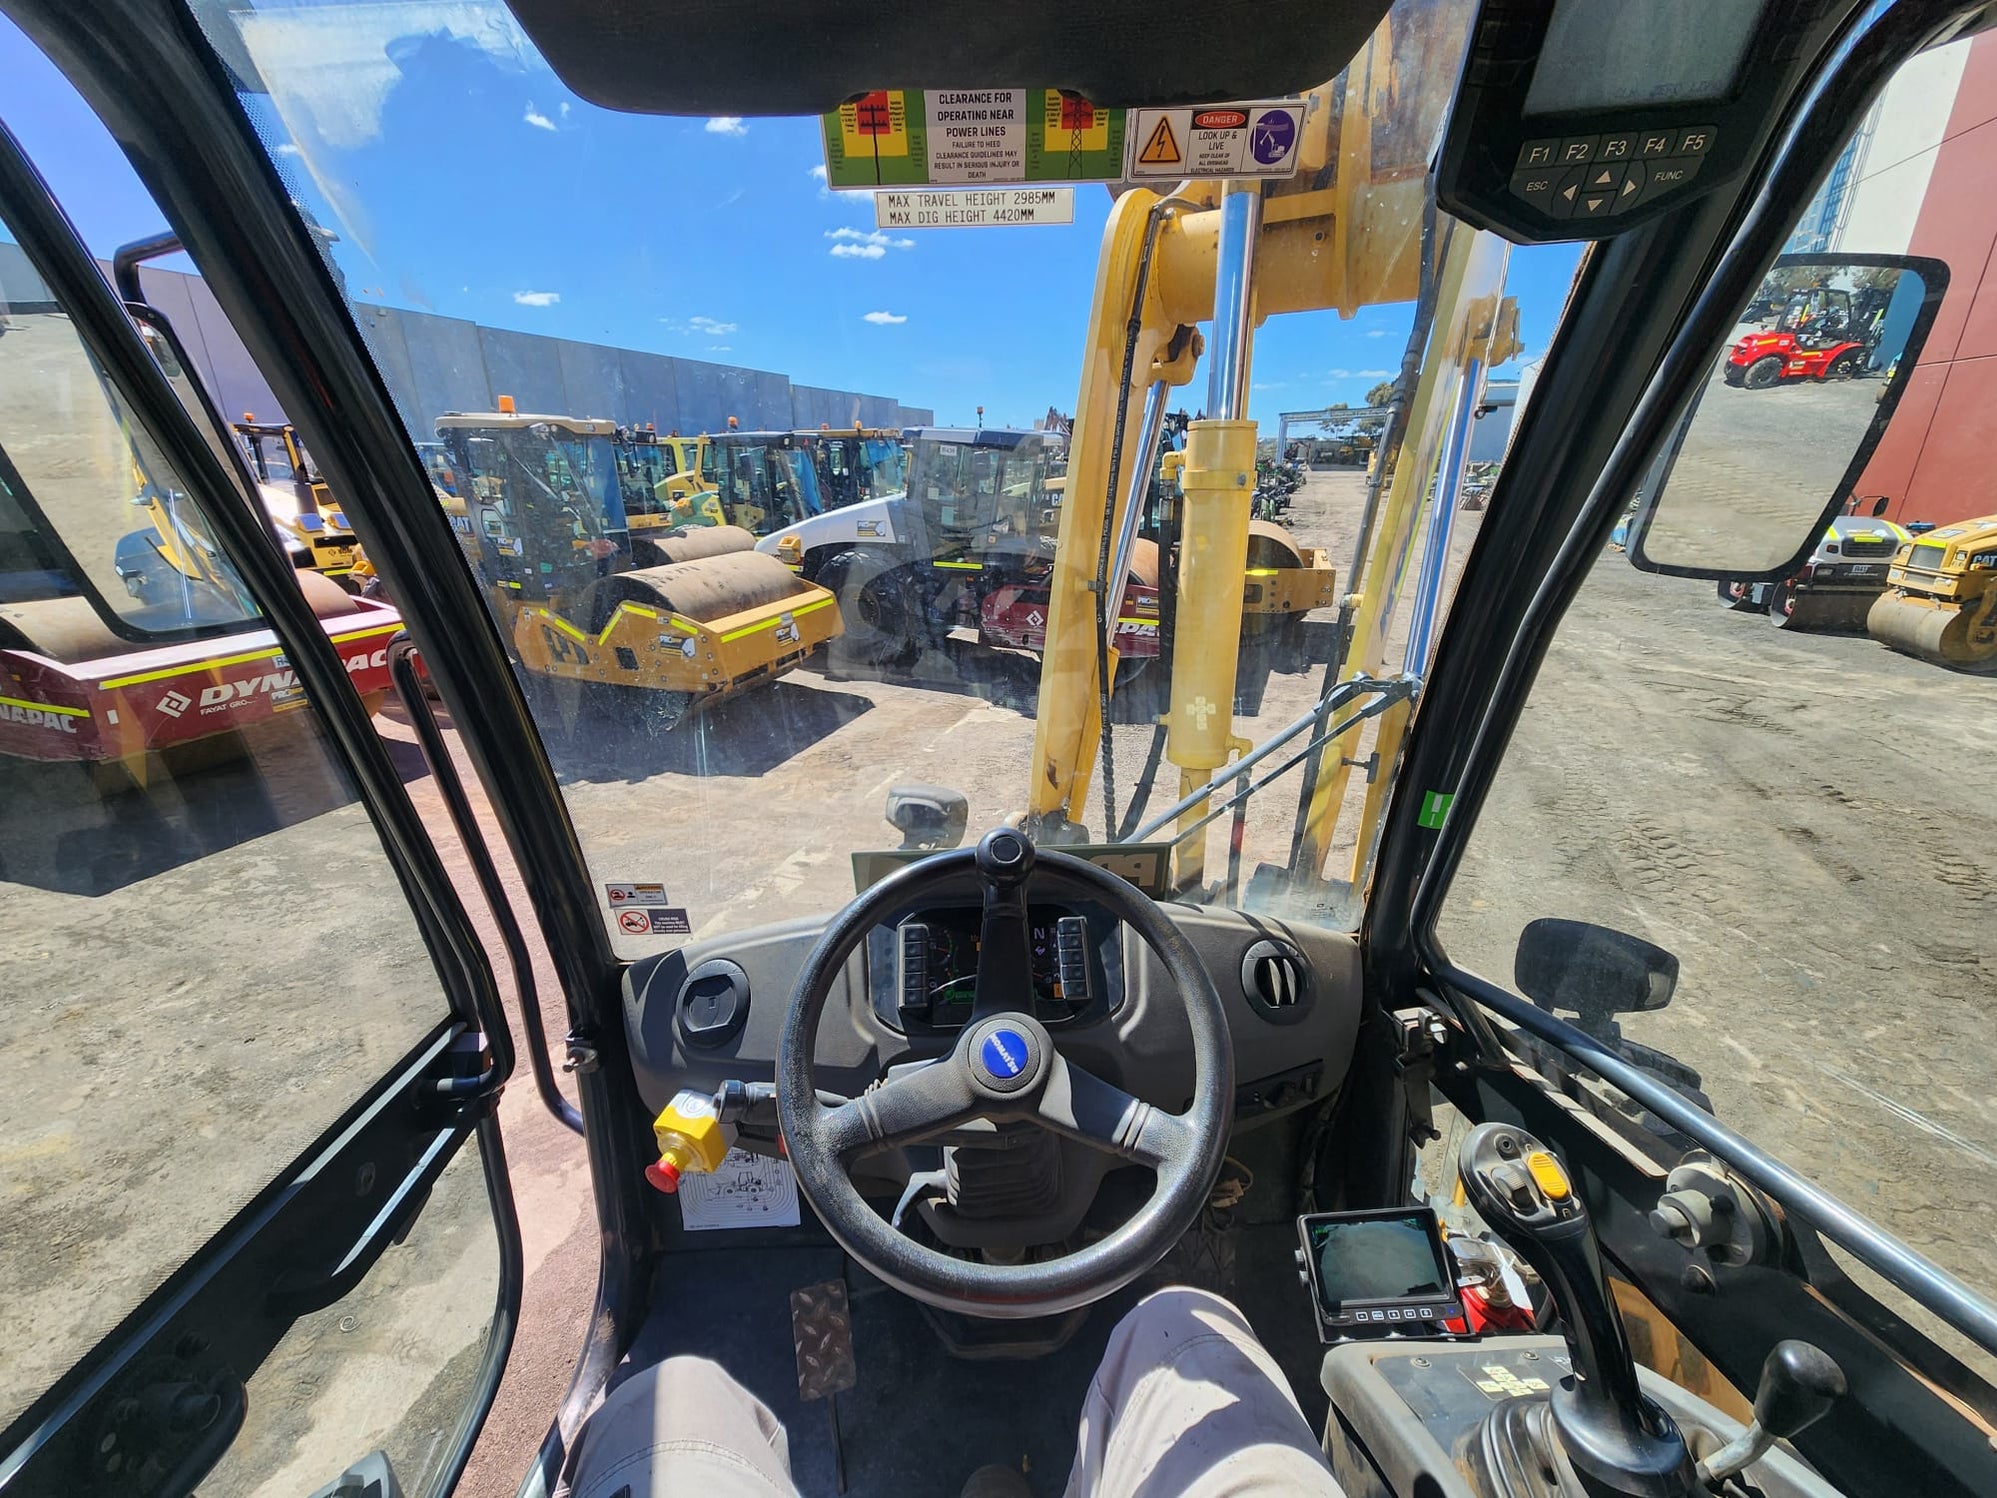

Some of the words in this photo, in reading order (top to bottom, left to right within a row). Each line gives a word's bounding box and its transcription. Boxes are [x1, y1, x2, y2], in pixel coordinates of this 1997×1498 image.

[939, 92, 992, 105] CLEARANCE
[994, 92, 1012, 103] FOR
[937, 110, 987, 121] OPERATING
[990, 109, 1014, 120] NEAR
[1202, 115, 1238, 124] DANGER
[946, 127, 978, 137] POWER
[980, 126, 1006, 136] LINES
[1198, 131, 1218, 140] LOOK
[1220, 131, 1230, 139] UP
[1231, 131, 1238, 139] &
[952, 141, 975, 149] FAILURE
[1208, 141, 1224, 150] LIVE
[1529, 147, 1550, 164] F1
[1565, 143, 1589, 160] F2
[1604, 140, 1626, 157] F3
[1644, 137, 1667, 153] F4
[1682, 134, 1706, 151] F5
[936, 151, 969, 159] CLEARANCE
[1654, 170, 1684, 182] FUNC
[1526, 180, 1548, 192] ESC
[888, 195, 910, 207] MAX
[917, 194, 958, 207] TRAVEL
[965, 192, 1007, 206] HEIGHT
[1014, 191, 1056, 205] 2985MM
[889, 211, 911, 224] MAX
[918, 210, 938, 223] DIG
[945, 209, 987, 222] HEIGHT
[993, 209, 1034, 222] 4420MM
[200, 704, 227, 716] FAYAT
[1033, 927, 1045, 940] N
[990, 1033, 1019, 1074] KOMATSU
